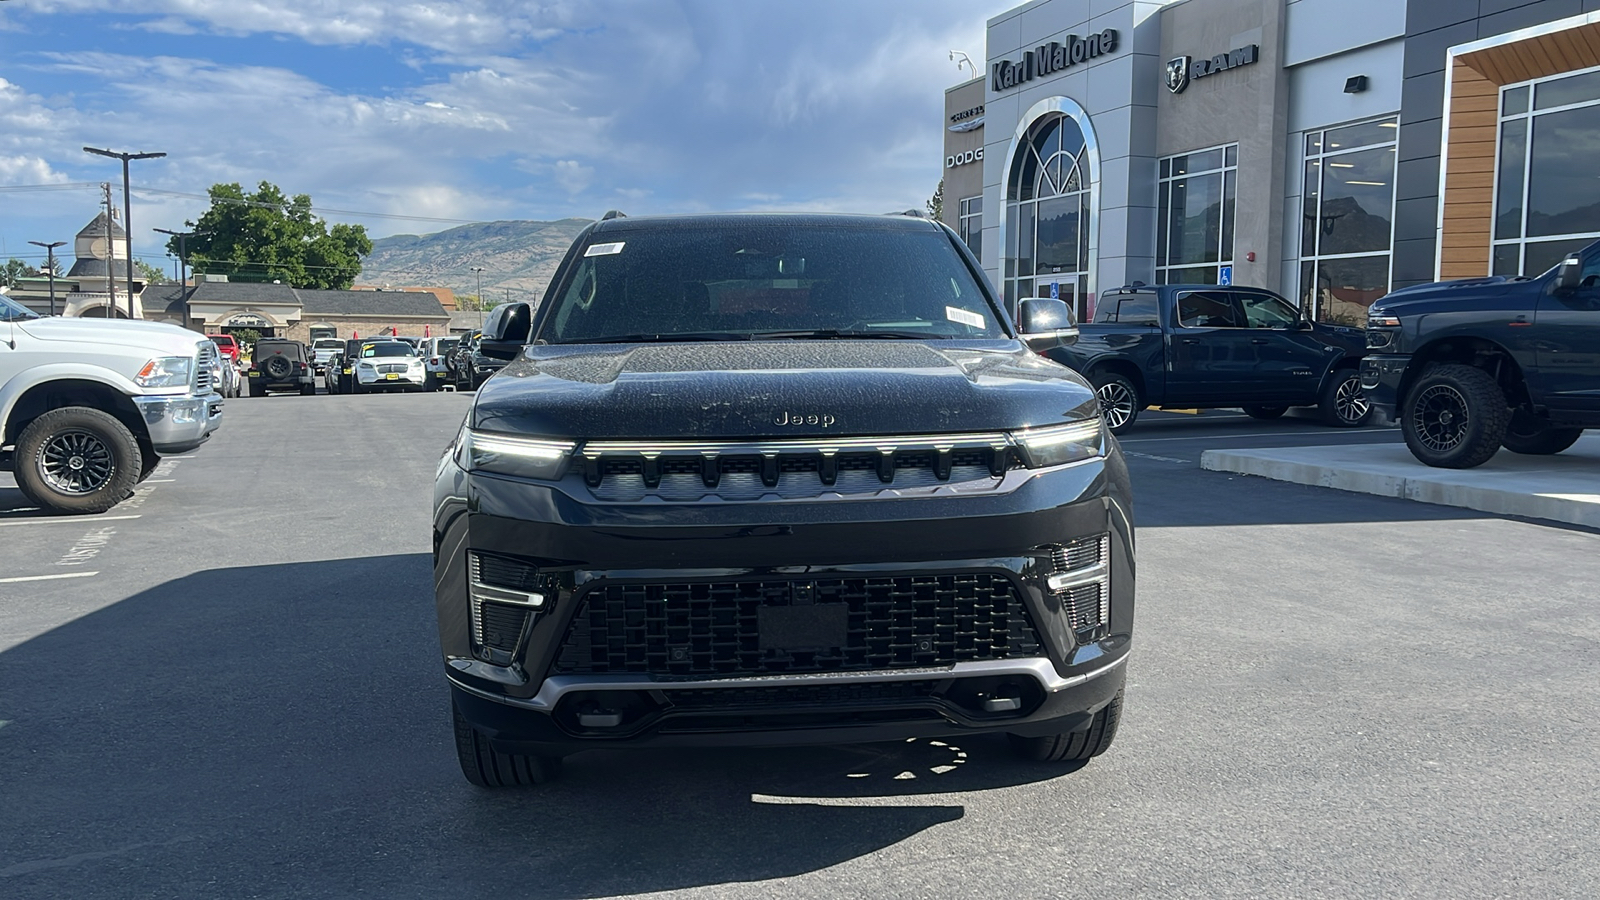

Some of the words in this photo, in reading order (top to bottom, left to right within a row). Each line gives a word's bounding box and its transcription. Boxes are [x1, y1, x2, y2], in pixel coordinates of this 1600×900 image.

[991, 51, 1033, 92] Karl
[1034, 28, 1118, 76] Malone
[1190, 44, 1259, 79] RAM
[773, 411, 835, 428] Jeep
